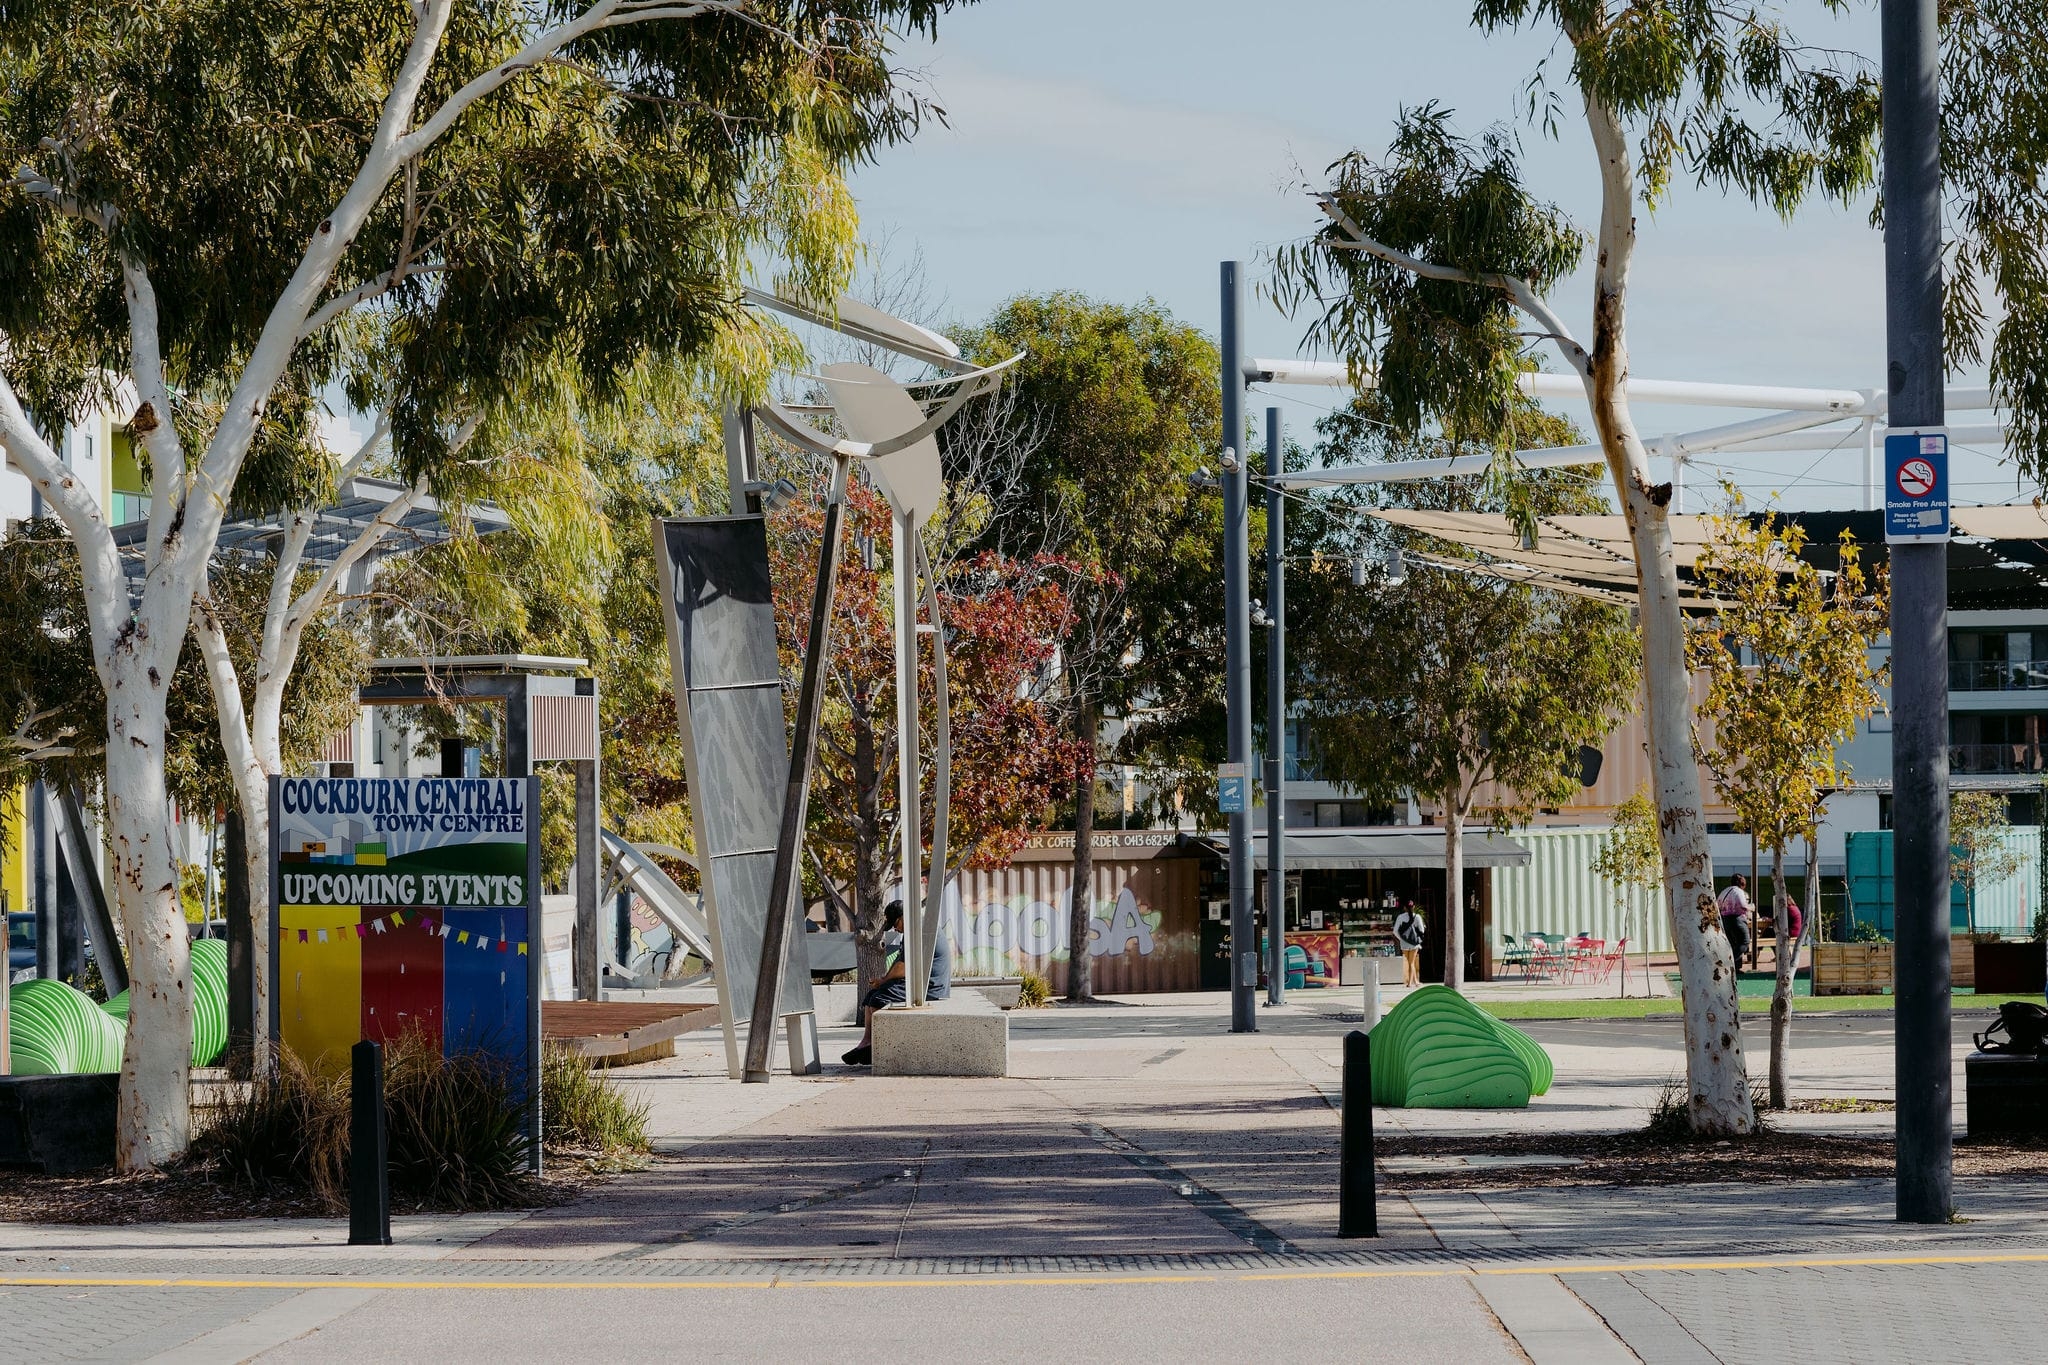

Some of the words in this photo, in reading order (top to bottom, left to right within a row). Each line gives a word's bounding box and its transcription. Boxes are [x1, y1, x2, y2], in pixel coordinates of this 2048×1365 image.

[1887, 501, 1911, 509] Smoke
[1912, 500, 1929, 508] Free
[282, 779, 408, 814] COCKBURN
[415, 779, 524, 815] CENTRAL
[373, 814, 434, 832] TOWN
[440, 814, 524, 833] CENTRE
[1022, 837, 1044, 849] UR
[1047, 836, 1076, 848] COFFE
[1091, 835, 1120, 847] RDER
[1124, 835, 1143, 847] 0413
[283, 873, 416, 905] UPCOMING
[422, 874, 523, 906] EVENTS
